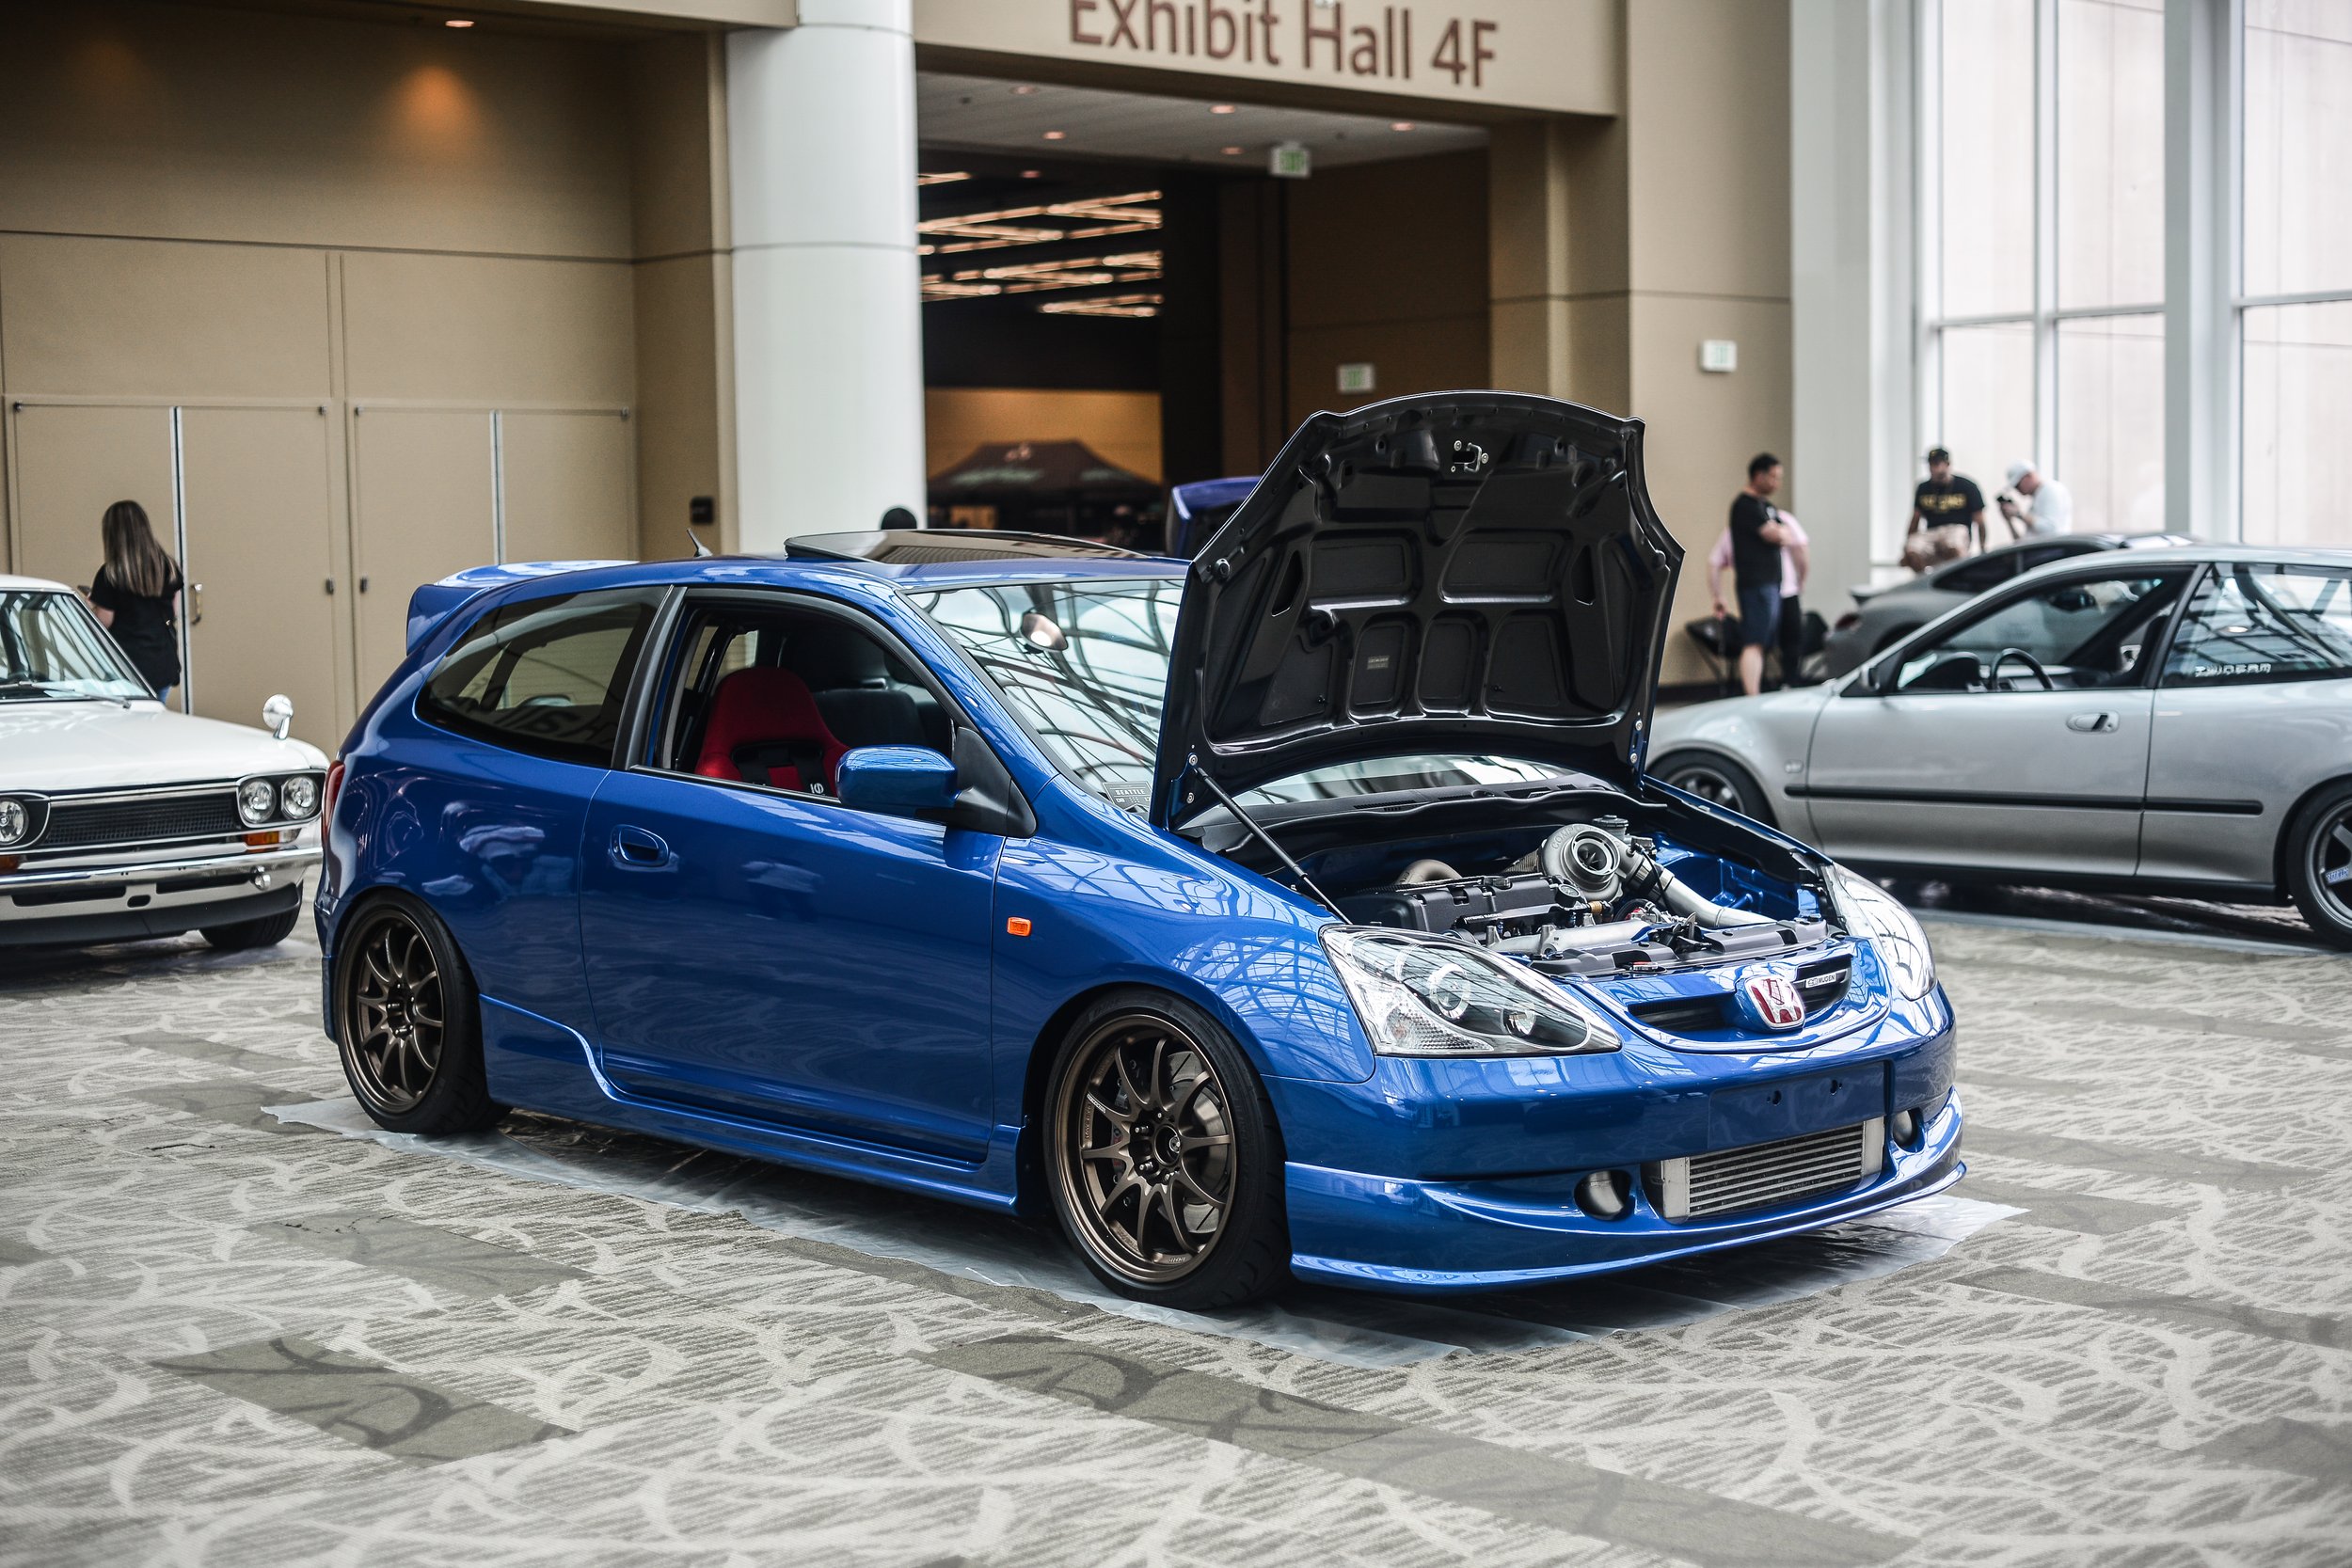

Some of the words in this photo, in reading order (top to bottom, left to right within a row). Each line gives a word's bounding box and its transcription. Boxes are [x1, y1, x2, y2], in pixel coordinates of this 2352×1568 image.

[1070, 0, 1280, 66] Exhibit
[1303, 0, 1412, 81] Hall
[1431, 18, 1499, 87] 4F
[1818, 974, 1836, 984] MUGEN
